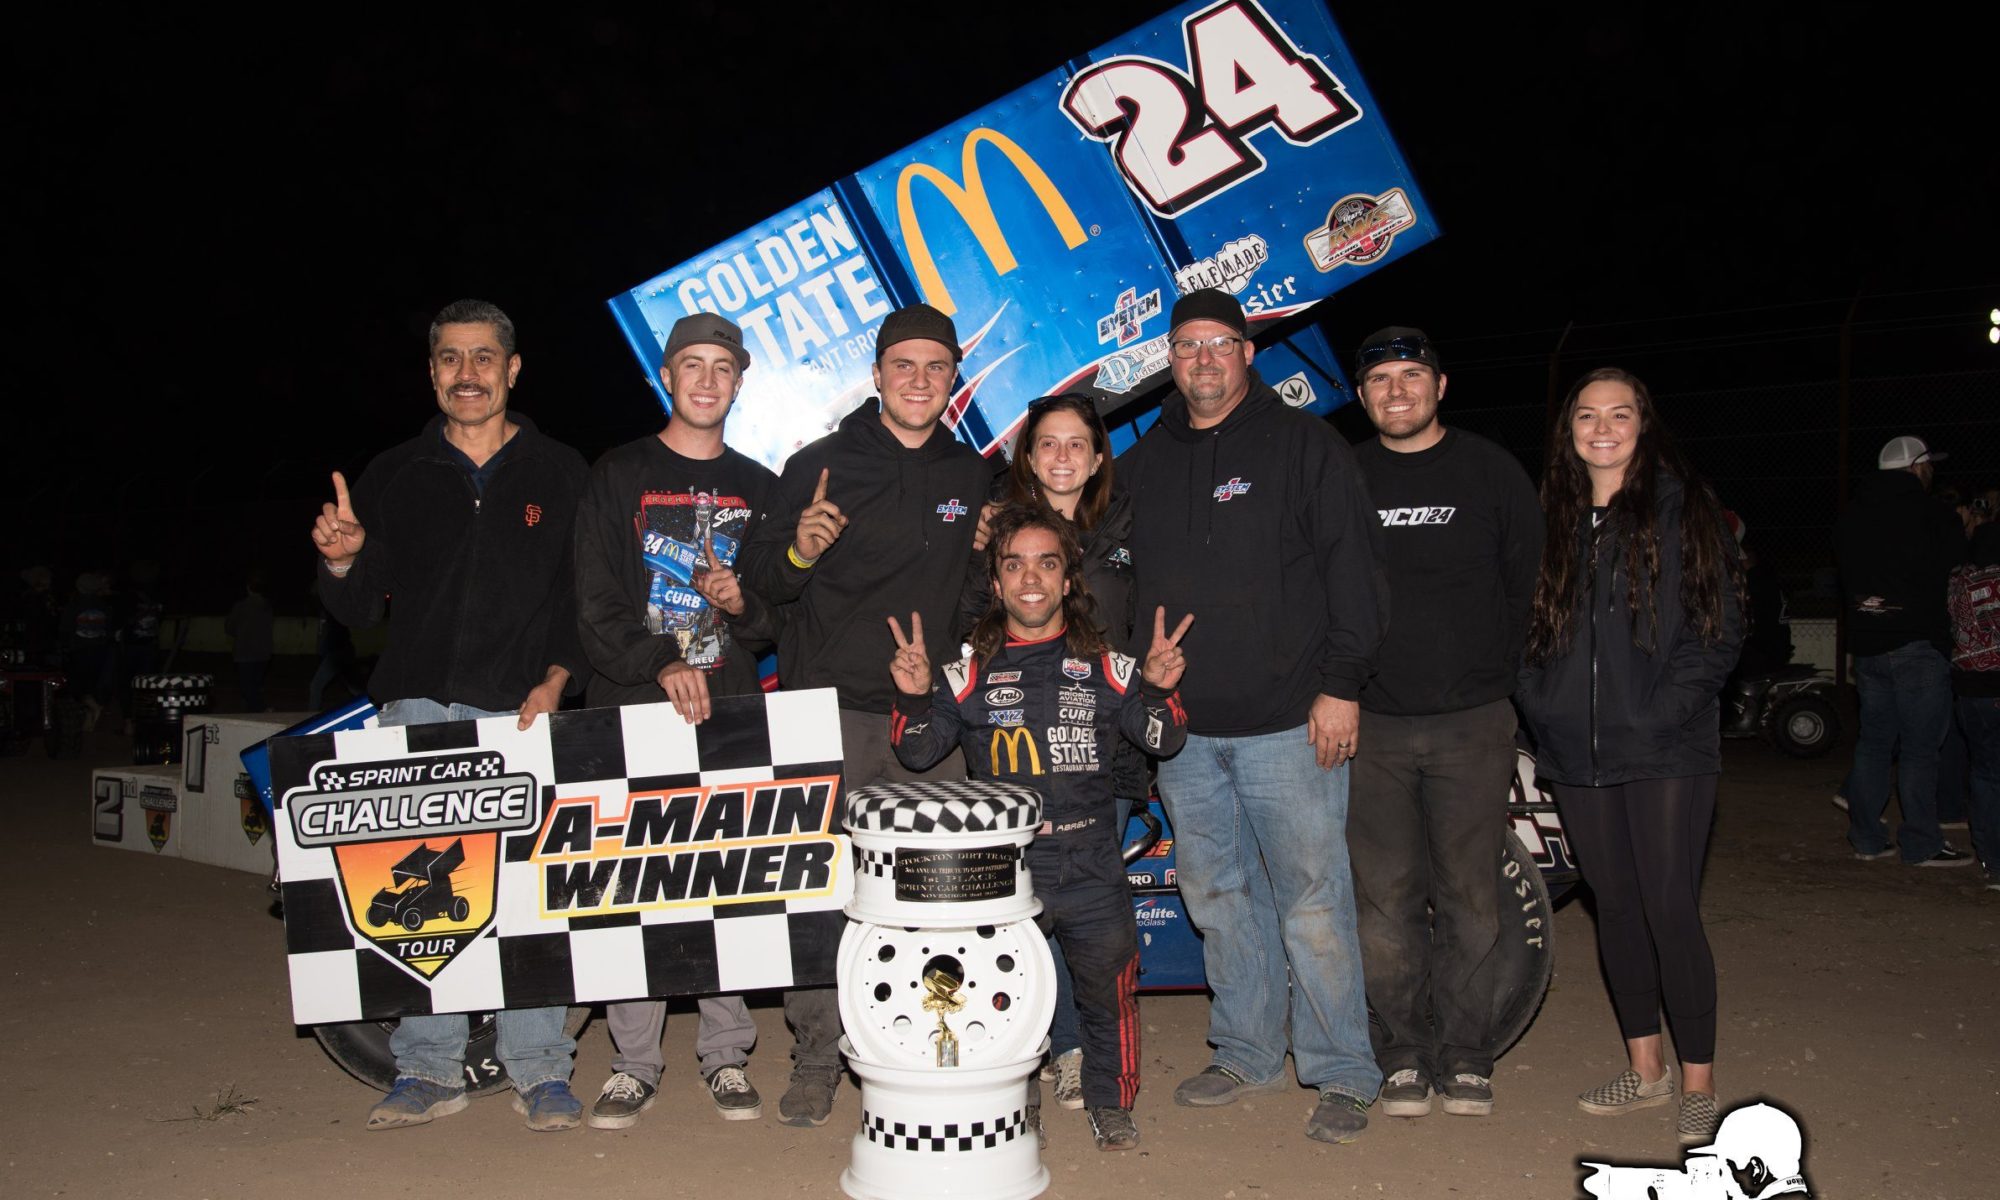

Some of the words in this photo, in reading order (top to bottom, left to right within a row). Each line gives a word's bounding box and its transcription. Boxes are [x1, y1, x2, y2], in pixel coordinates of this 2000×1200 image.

[1062, 0, 1357, 214] 24
[677, 203, 858, 316] GOLDEN
[1179, 266, 1220, 295] SELF
[1221, 243, 1266, 278] MADE
[1243, 276, 1297, 315] sier
[736, 254, 896, 370] TATE
[1100, 291, 1159, 337] SYSTEM
[809, 346, 844, 376] ANT
[849, 323, 882, 361] GRO
[1101, 336, 1170, 387] DANCE
[1214, 483, 1251, 497] SYSTEM
[712, 508, 752, 528] Sweep
[936, 504, 968, 515] SYSTEM
[644, 533, 665, 555] 24
[665, 590, 702, 608] CURB
[688, 656, 715, 665] BREU
[1059, 690, 1096, 699] PRIORITY
[1059, 696, 1096, 704] AVIATION
[988, 709, 1024, 724] XYZ
[1059, 708, 1095, 721] CURB
[1050, 743, 1099, 764] STATE
[348, 764, 427, 788] SPRINT
[430, 760, 473, 780] CAR
[300, 785, 528, 836] CHALLENGE
[540, 784, 831, 855] A-MAIN
[898, 853, 953, 866] STOCKTON
[546, 841, 836, 911] WINNER
[898, 883, 935, 892] SPRINT
[937, 884, 958, 892] CAR
[961, 880, 1014, 891] CHALLENGE
[945, 873, 998, 883] PLACE
[1136, 907, 1178, 920] felite.
[1136, 918, 1167, 927] toGlass
[397, 937, 457, 958] TOUR
